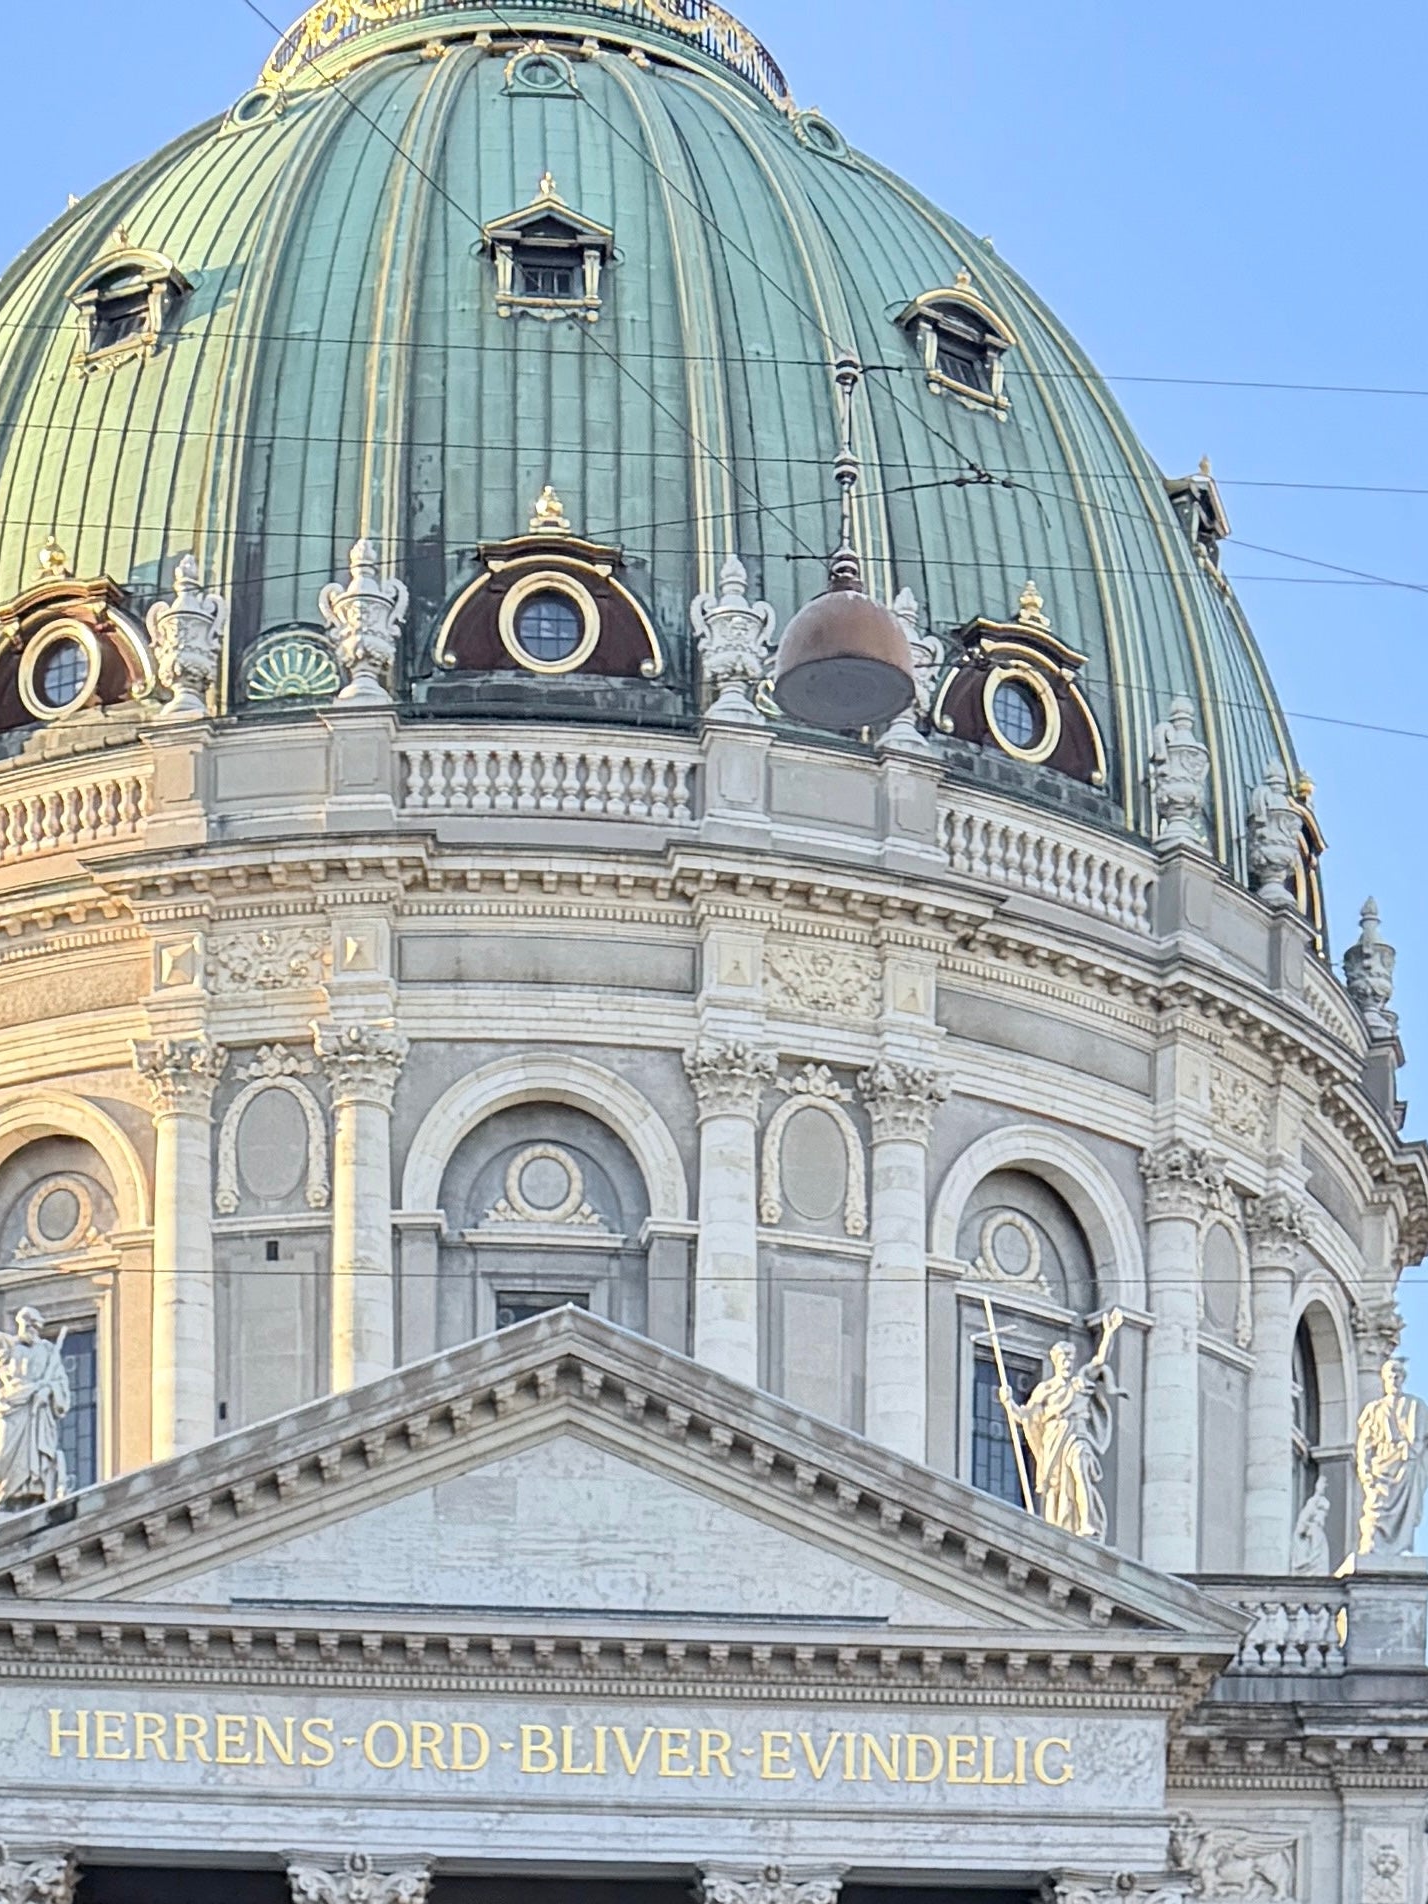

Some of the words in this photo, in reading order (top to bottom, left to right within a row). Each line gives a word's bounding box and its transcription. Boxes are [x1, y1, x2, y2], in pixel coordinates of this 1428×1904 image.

[47, 1707, 336, 1767] HERRENS
[363, 1719, 491, 1772] ORD
[519, 1723, 736, 1778] BLIVER
[759, 1730, 1075, 1786] EVINDELIG
